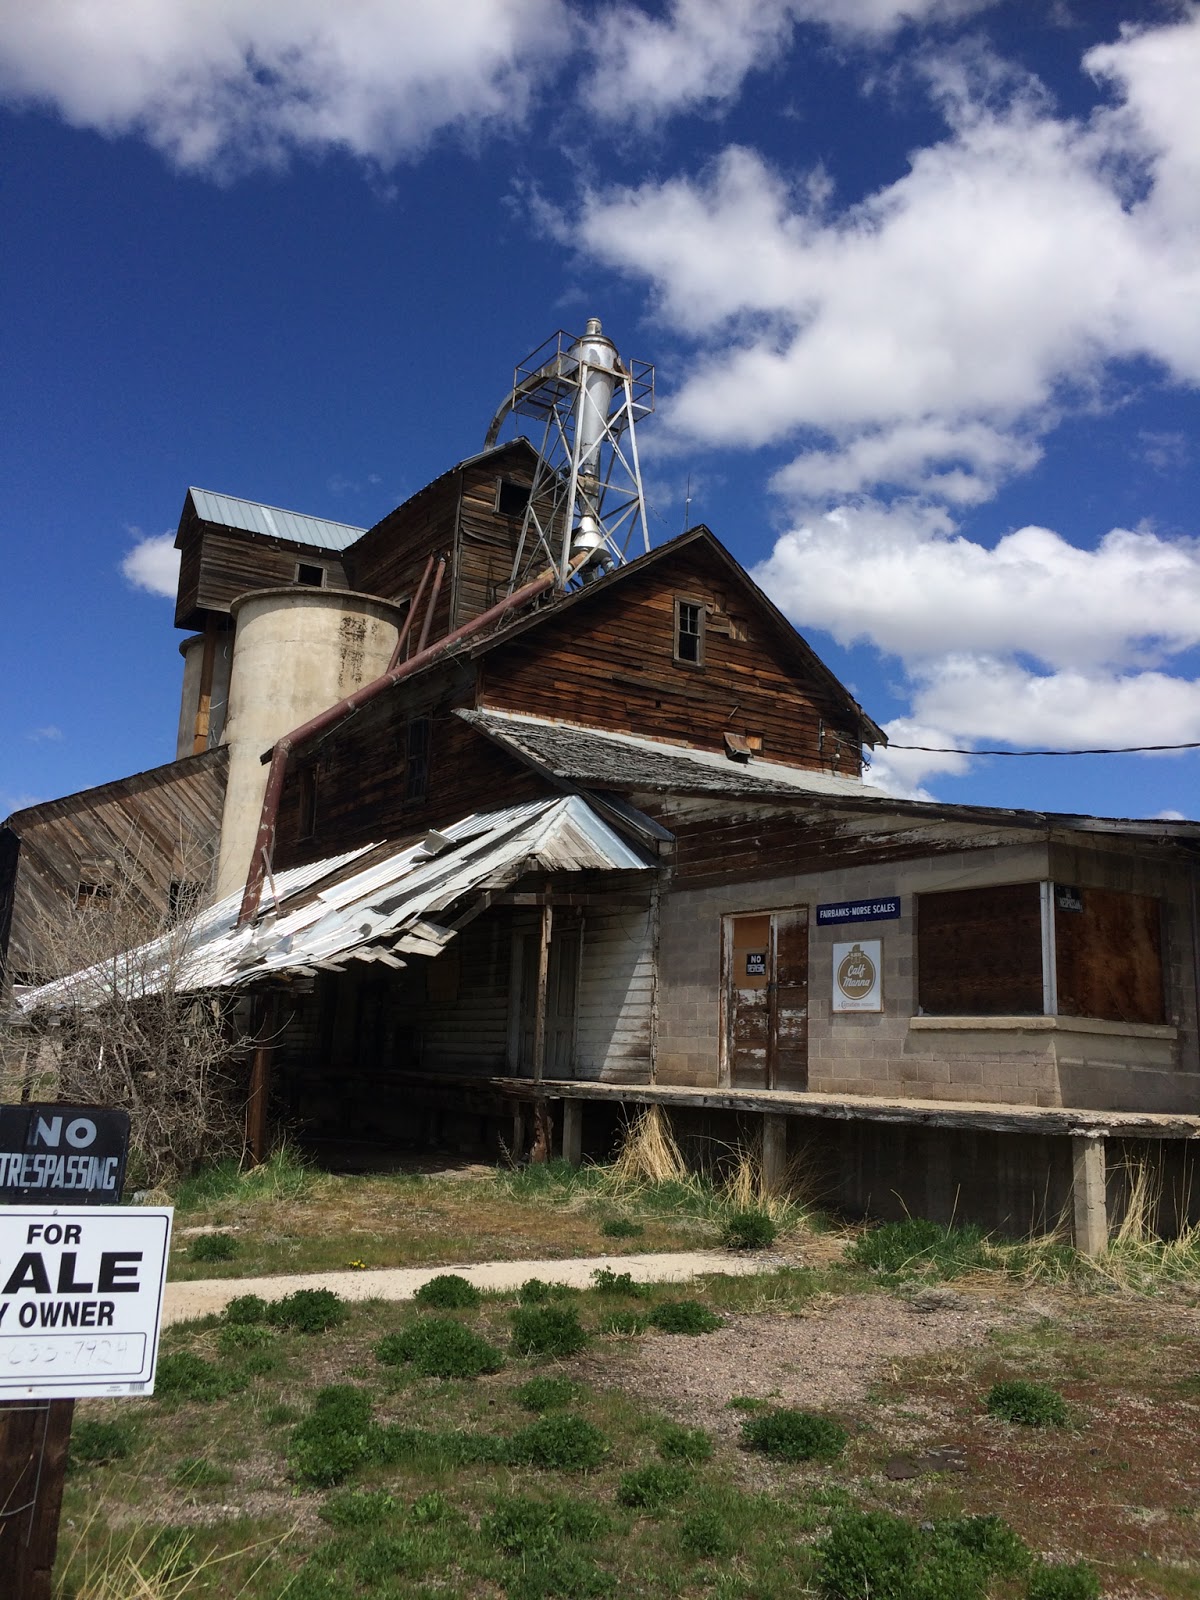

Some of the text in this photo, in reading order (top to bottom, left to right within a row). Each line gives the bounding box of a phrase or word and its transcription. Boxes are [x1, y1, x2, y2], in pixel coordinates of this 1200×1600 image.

[873, 903, 895, 914] SCALES
[750, 955, 762, 964] NO
[843, 976, 871, 987] Manna
[848, 964, 866, 978] Calf
[27, 1115, 98, 1149] NO
[0, 1152, 119, 1190] TRESPASSING
[26, 1224, 83, 1246] FOR
[0, 1251, 144, 1295] ALE
[0, 1301, 116, 1329] Y OWNER
